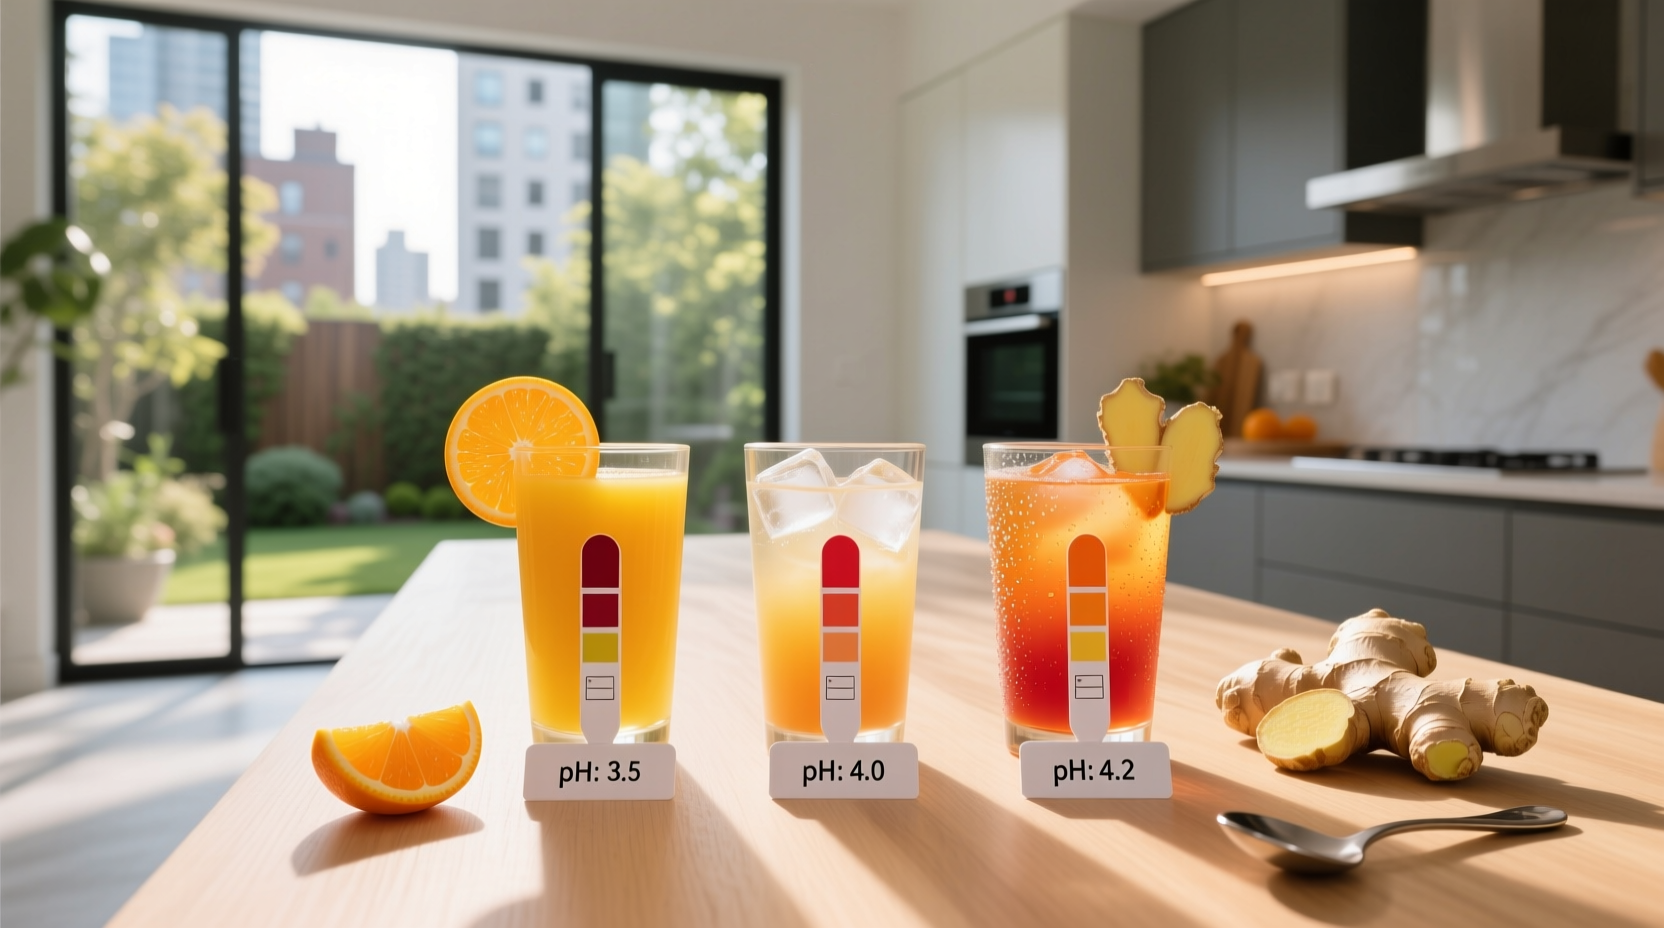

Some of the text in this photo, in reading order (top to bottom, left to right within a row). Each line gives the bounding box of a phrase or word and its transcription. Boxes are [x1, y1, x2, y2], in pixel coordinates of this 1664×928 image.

[558, 760, 641, 789] pH: 3.5
[802, 759, 885, 788] pH: 4.0
[1053, 758, 1135, 788] pH: 4.2
